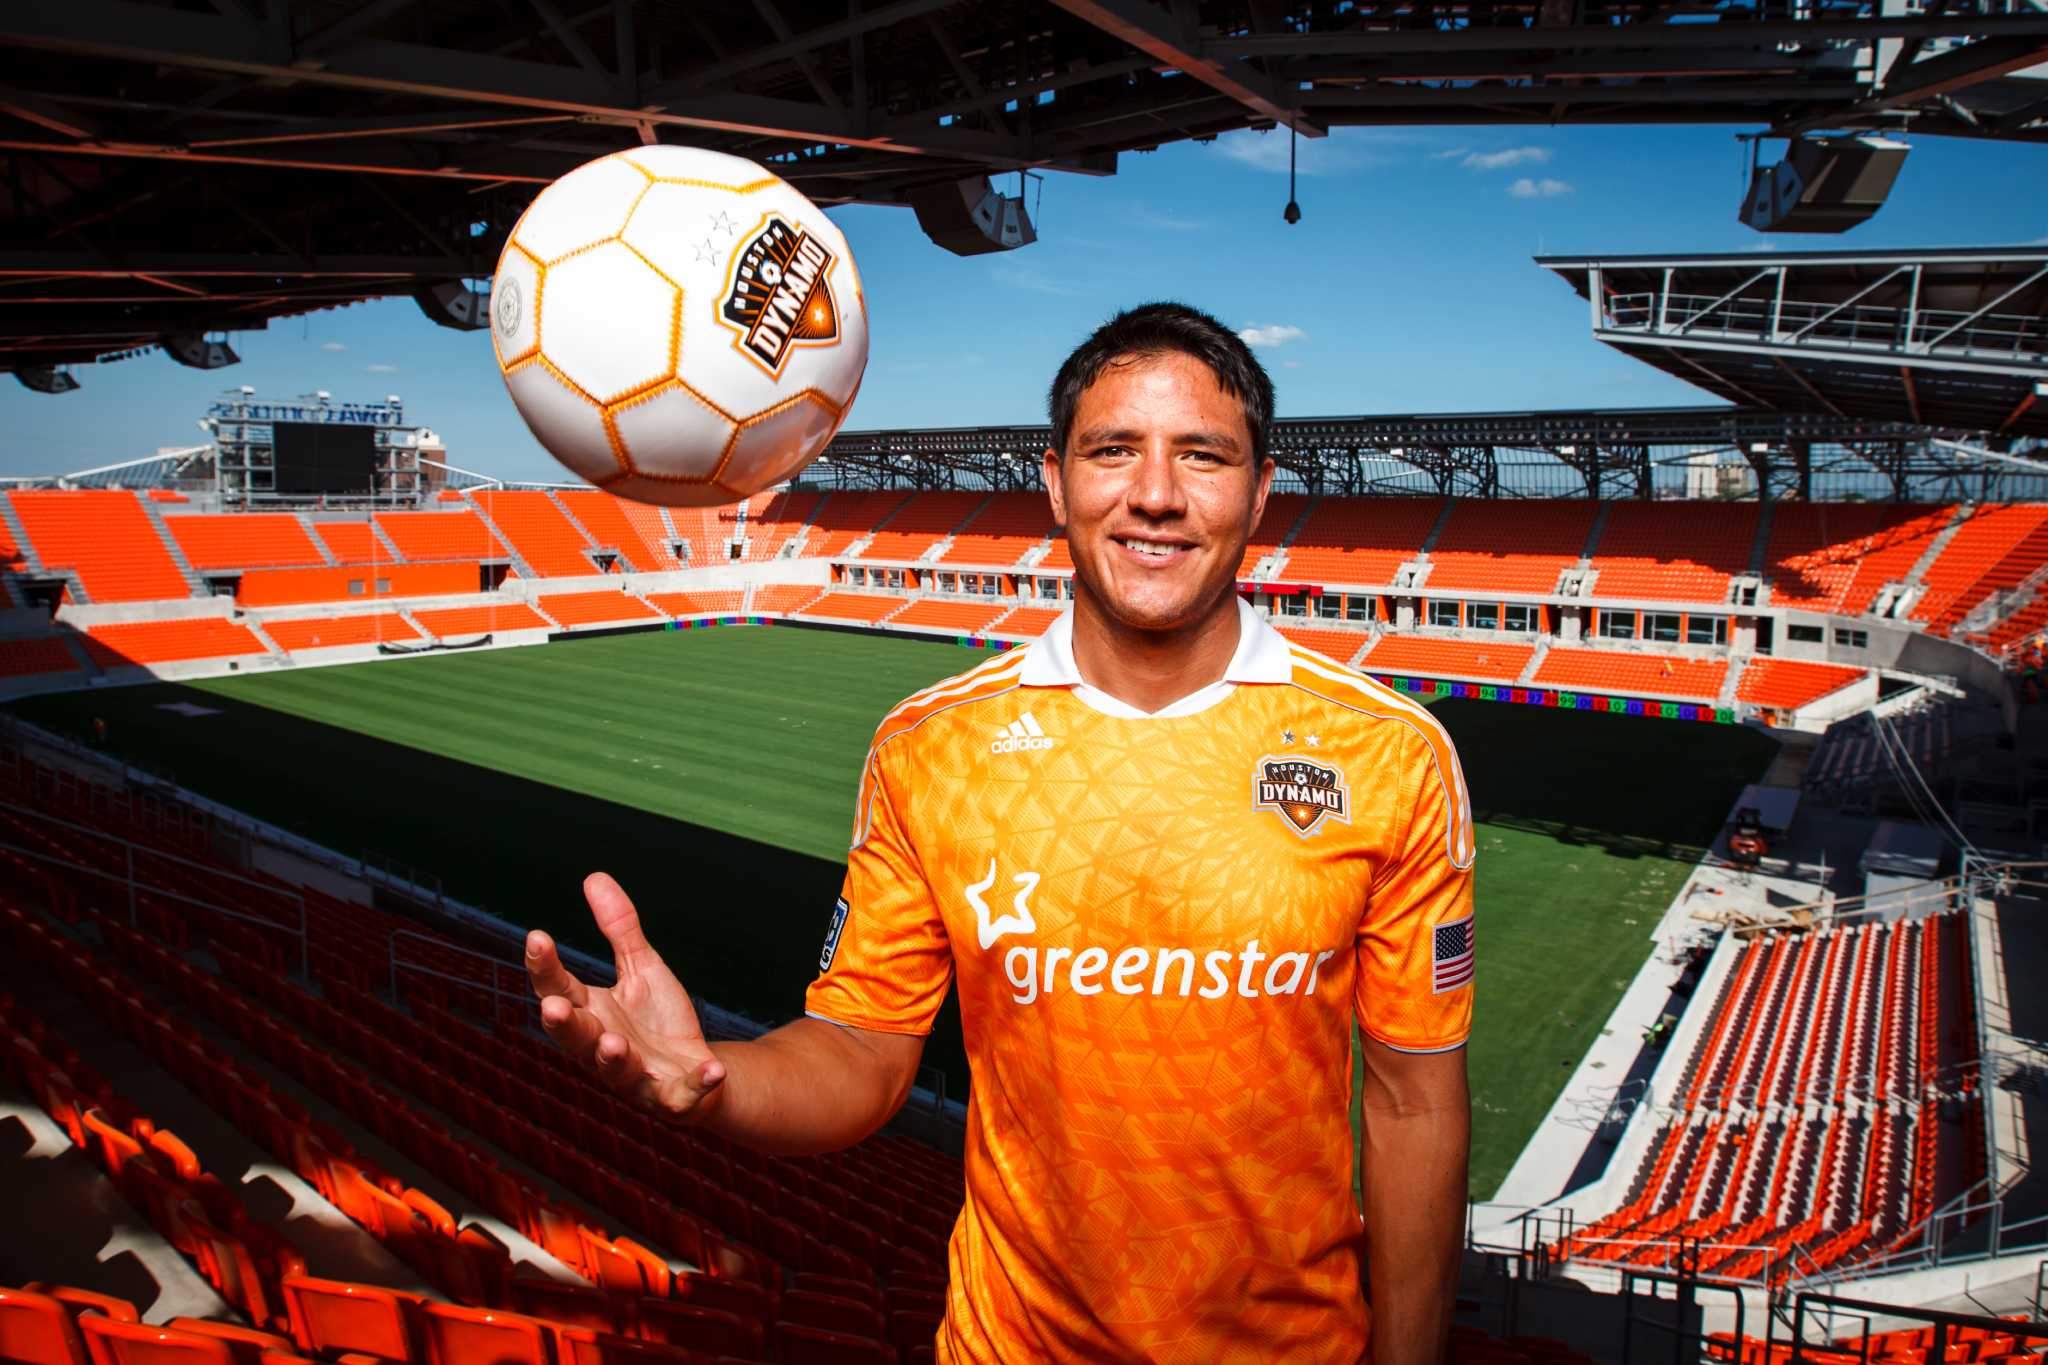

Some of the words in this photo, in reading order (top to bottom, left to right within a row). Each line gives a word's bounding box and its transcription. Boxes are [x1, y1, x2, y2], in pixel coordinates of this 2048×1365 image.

[734, 226, 783, 310] HOUSTON
[751, 236, 828, 358] DYNAMO
[1561, 695, 1576, 706] 99
[991, 735, 1053, 754] adidas
[1271, 764, 1330, 779] HOUSTON
[1262, 783, 1340, 808] DYNAMO
[1004, 939, 1334, 1005] greenstar
